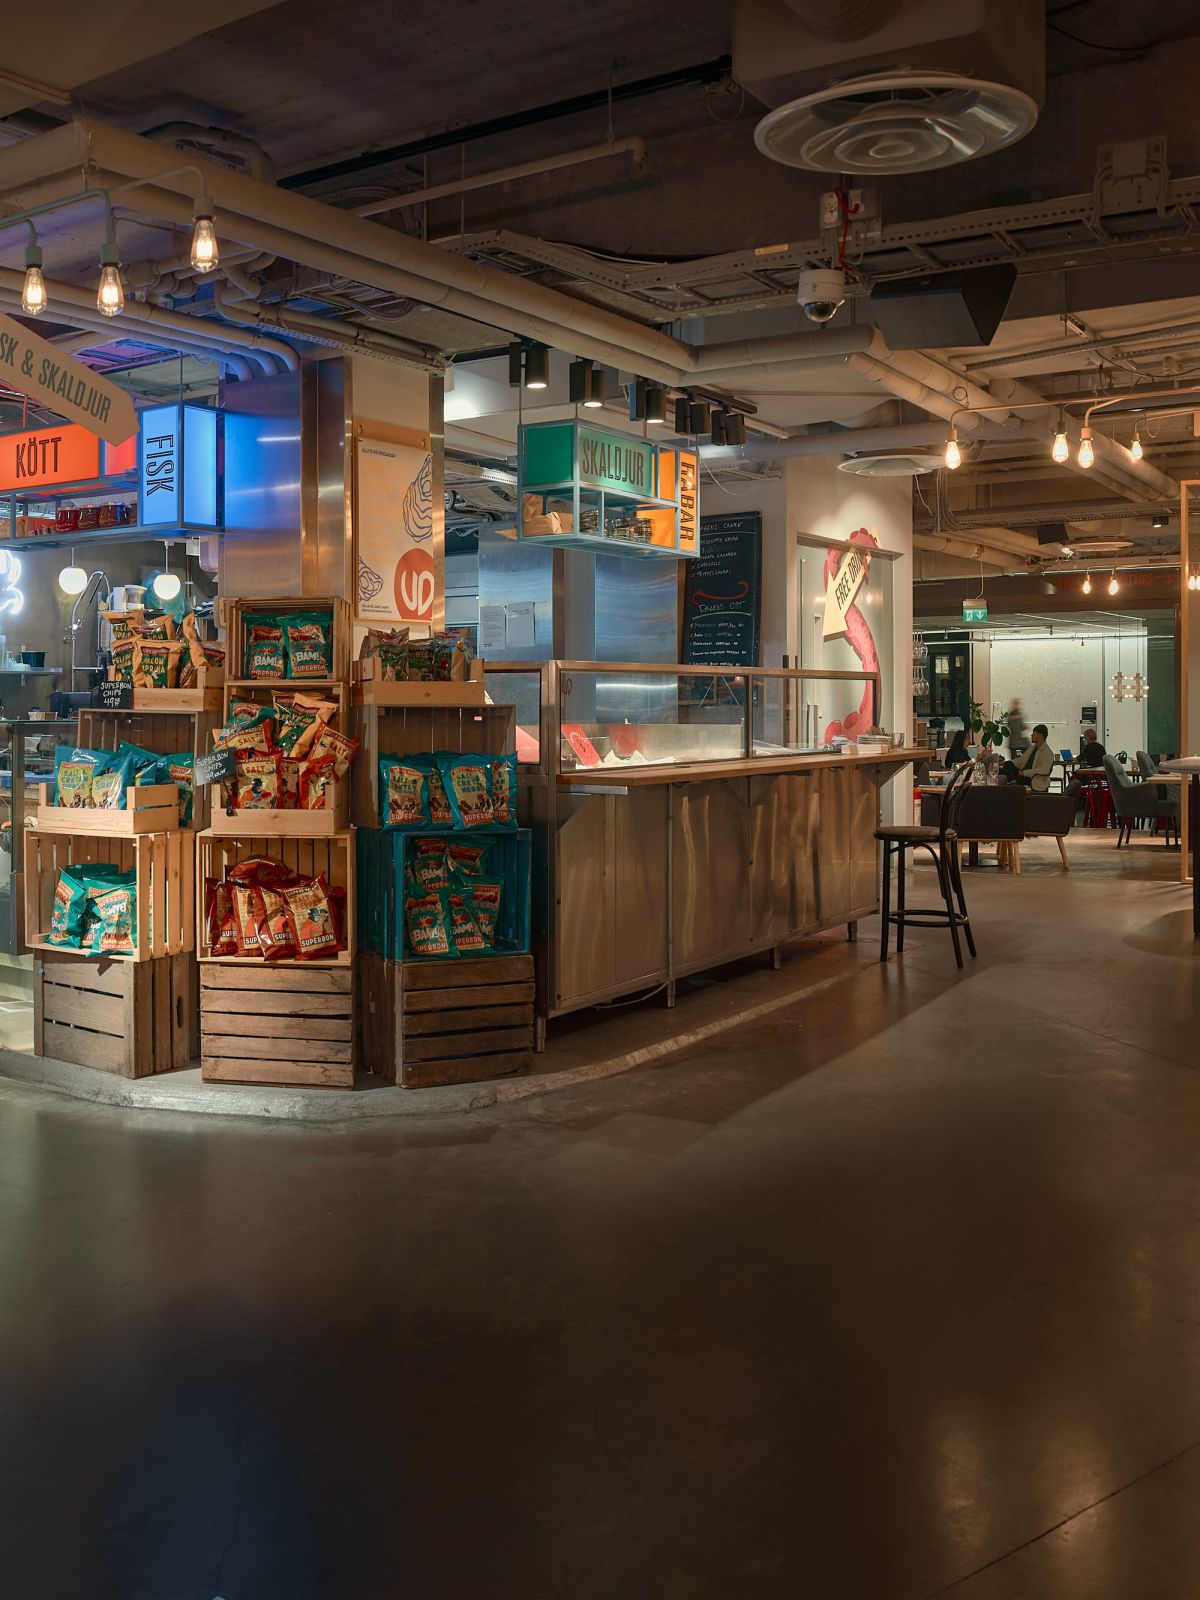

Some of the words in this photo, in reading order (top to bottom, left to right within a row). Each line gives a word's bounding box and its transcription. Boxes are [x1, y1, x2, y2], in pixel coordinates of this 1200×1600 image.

[21, 349, 33, 378] &
[38, 358, 112, 424] SKALDJUR
[16, 436, 62, 478] KÖTT
[582, 438, 644, 487] SKALDJUR
[146, 434, 174, 496] FISK
[401, 569, 434, 616] UD
[835, 571, 851, 610] FREE
[253, 655, 278, 667] BAM!
[295, 651, 320, 662] BAM!
[100, 681, 132, 690] SUPERBON
[102, 689, 122, 697] CHIPS
[245, 764, 266, 774] SALT
[391, 811, 413, 820] SUPER
[221, 930, 237, 938] SUPE
[274, 932, 294, 941] SUPER
[301, 934, 335, 947] SUPERBON
